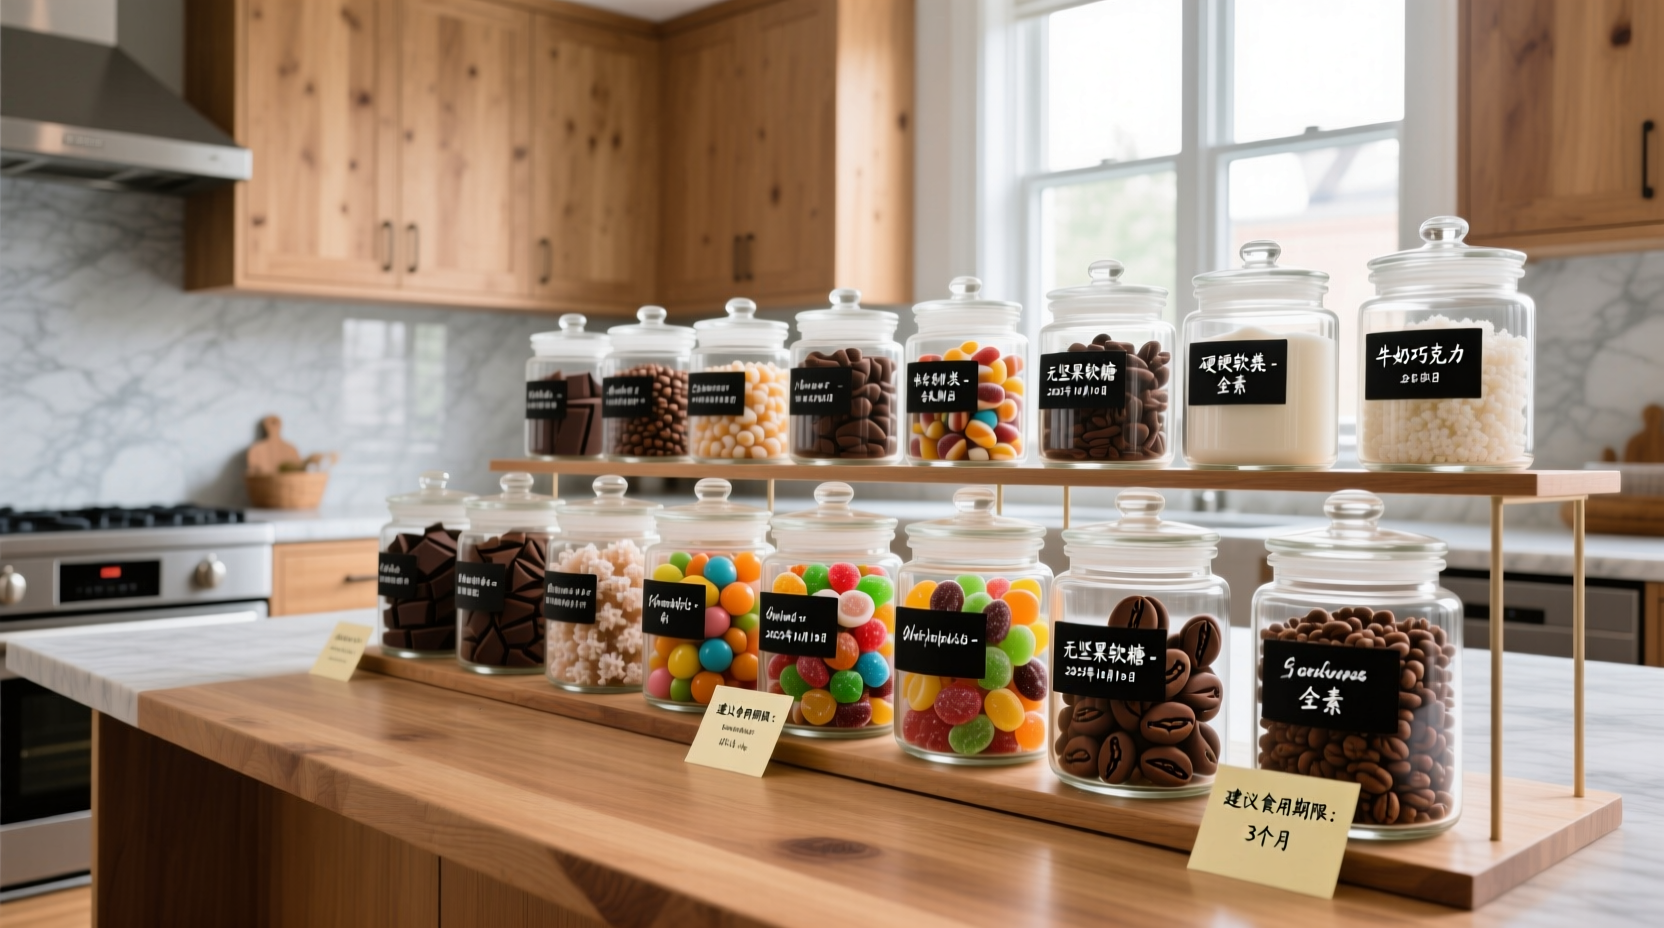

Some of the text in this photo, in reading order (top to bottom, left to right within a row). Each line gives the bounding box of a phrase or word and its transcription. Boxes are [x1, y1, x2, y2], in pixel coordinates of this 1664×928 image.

[1376, 342, 1464, 368] 牛奶巧克力
[1217, 374, 1247, 395] 全素
[1298, 685, 1344, 716] 全素
[1223, 788, 1336, 823] 建议食用期限：
[1244, 825, 1290, 852] 3个月
